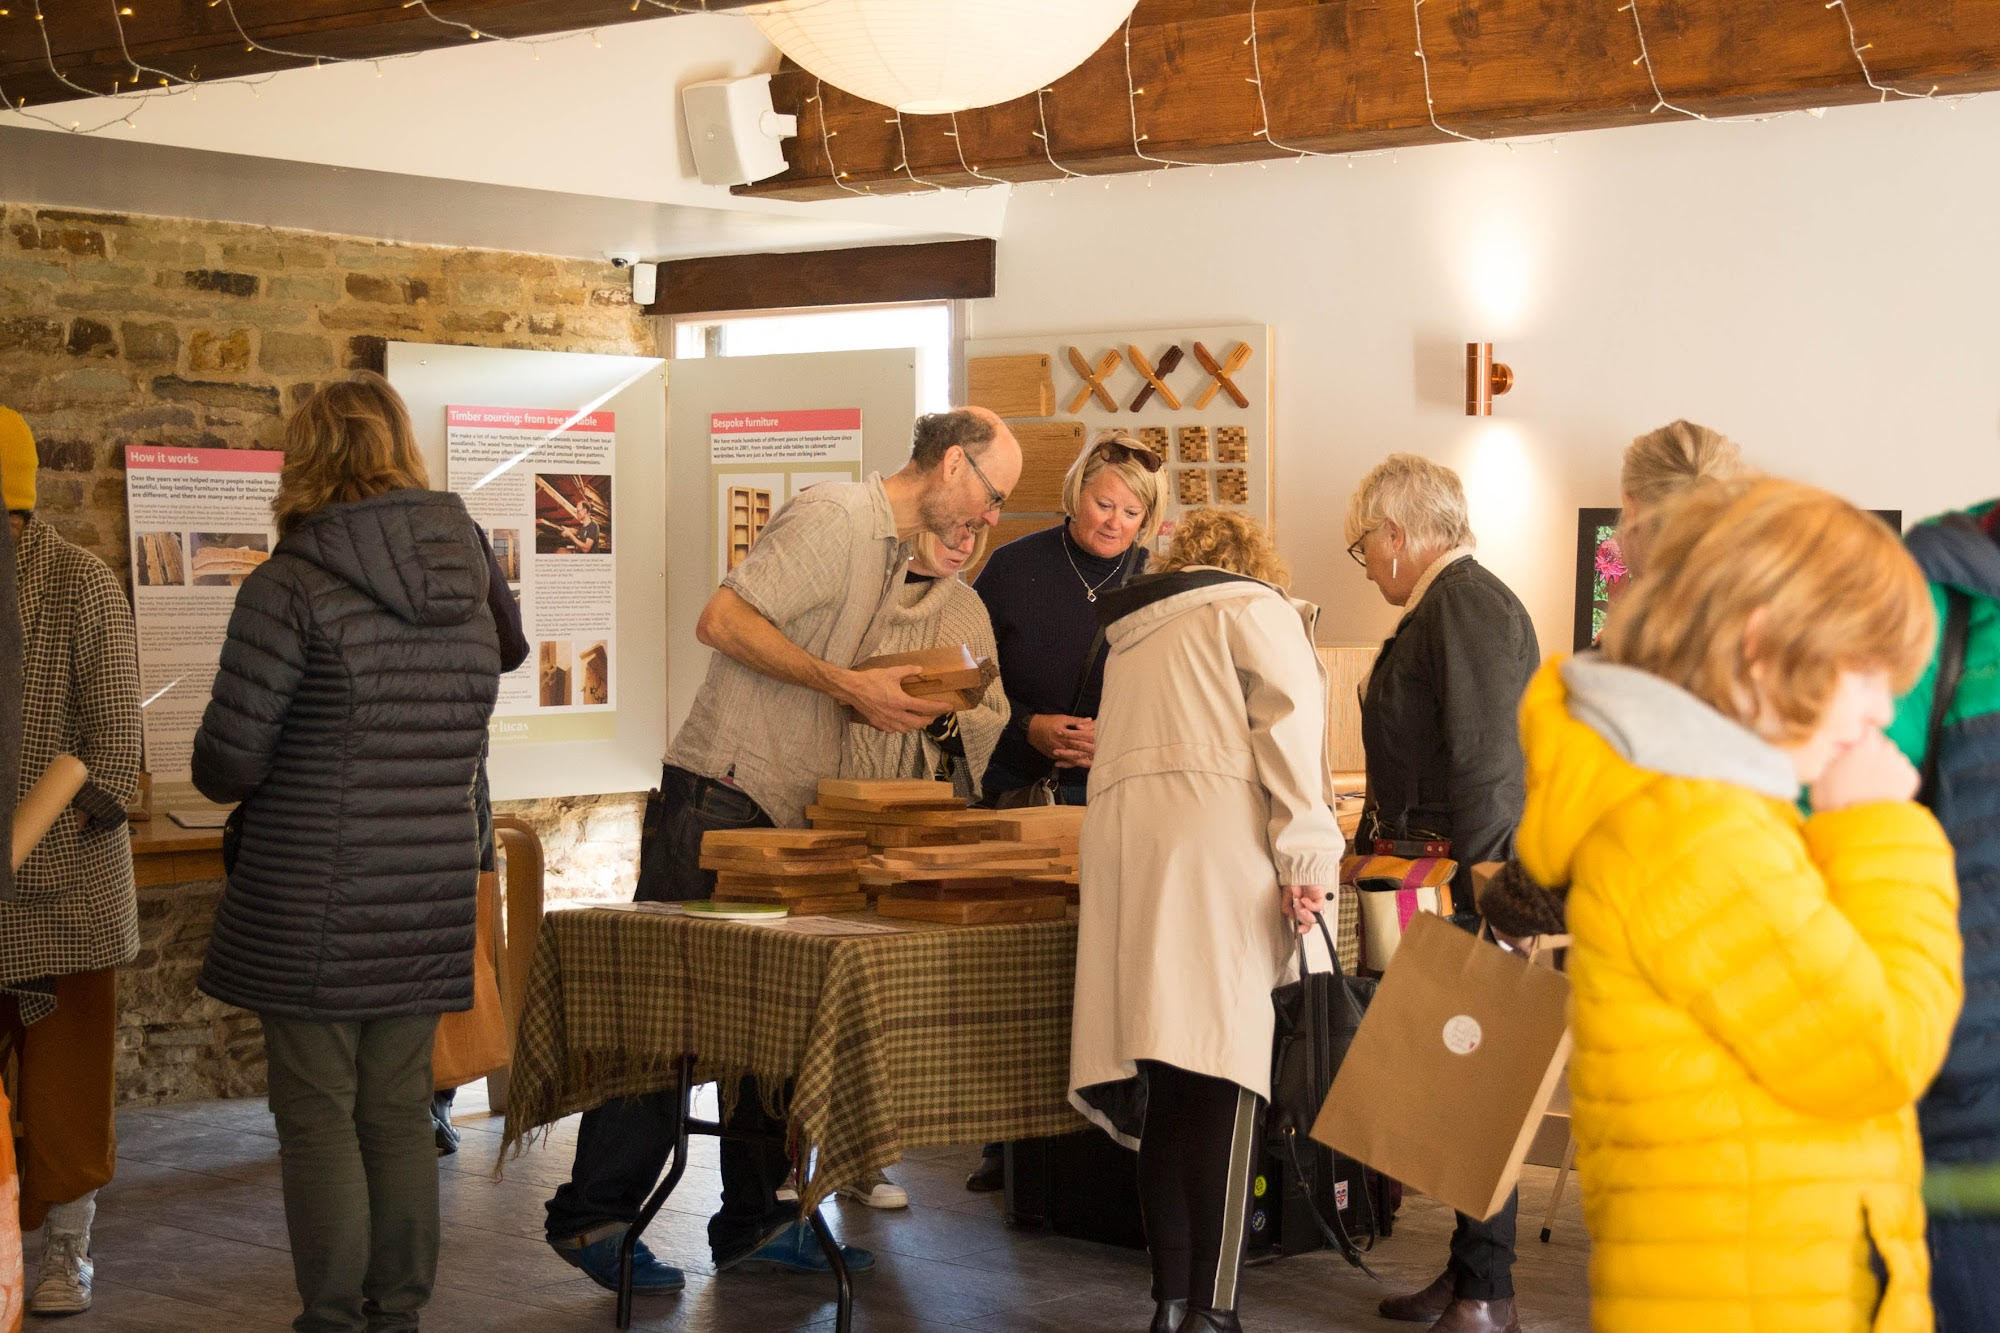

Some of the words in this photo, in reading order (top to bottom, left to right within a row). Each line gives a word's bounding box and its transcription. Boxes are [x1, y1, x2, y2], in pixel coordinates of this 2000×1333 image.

[450, 410, 482, 422] Timber
[483, 412, 522, 426] sourcing:
[524, 413, 545, 424] from
[547, 415, 564, 425] tree
[712, 417, 744, 430] Bespoke
[745, 416, 779, 427] furniture
[130, 451, 155, 463] How
[157, 451, 166, 463] it
[167, 453, 200, 464] works
[189, 476, 208, 484] helped
[131, 483, 157, 491] beautiful,
[160, 483, 193, 492] long-lasting
[142, 491, 169, 499] different,
[500, 720, 528, 732] lucas
